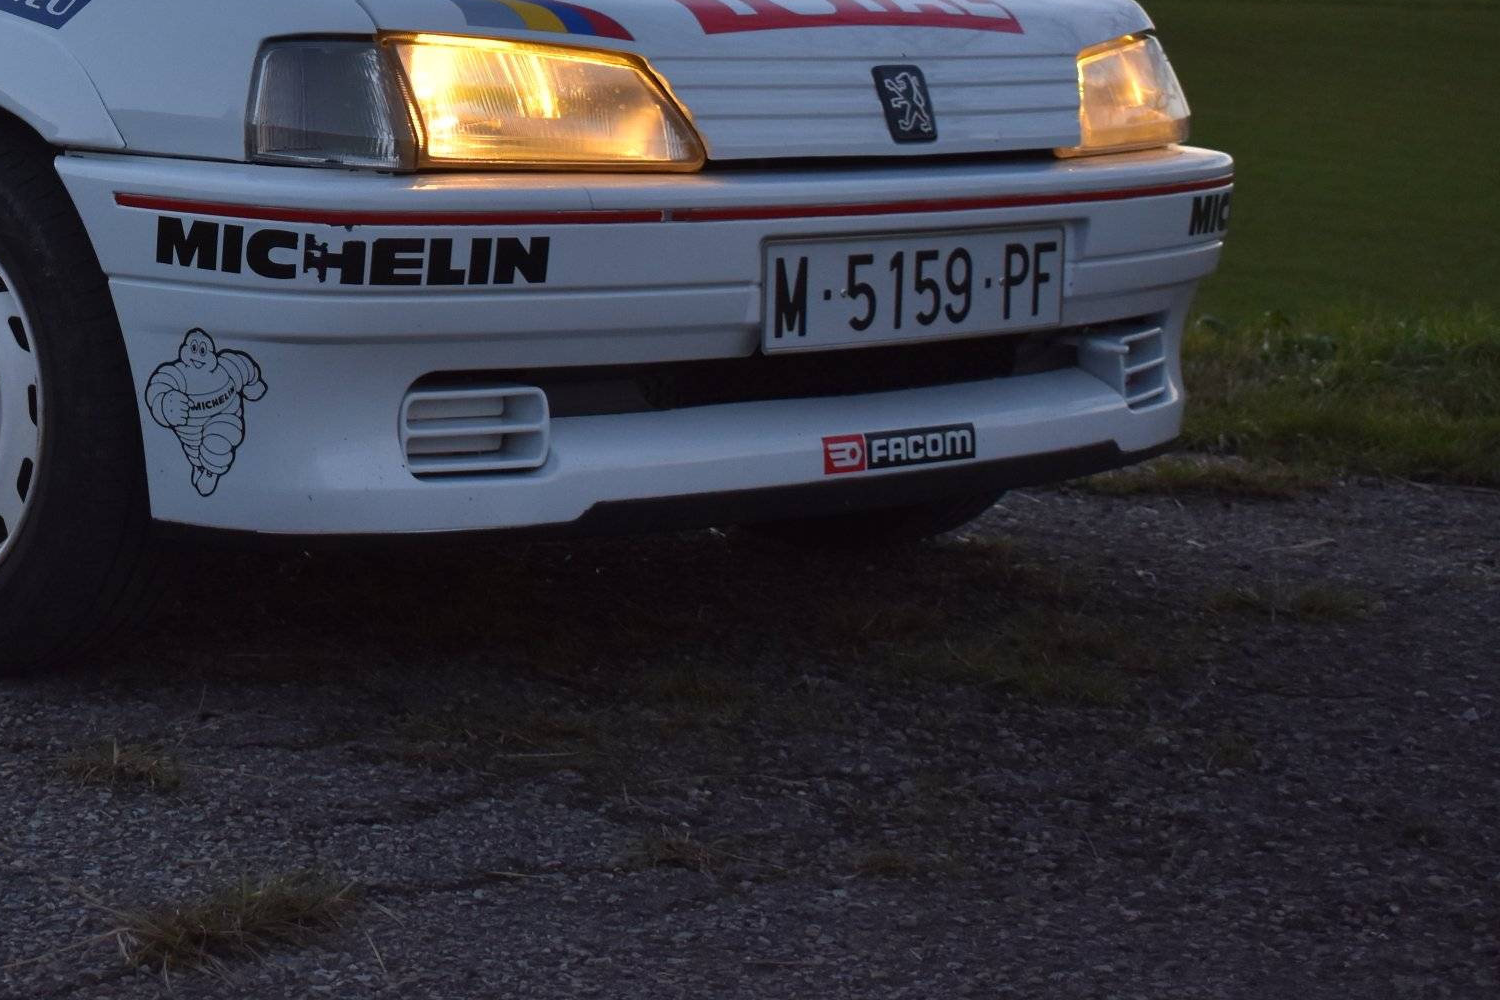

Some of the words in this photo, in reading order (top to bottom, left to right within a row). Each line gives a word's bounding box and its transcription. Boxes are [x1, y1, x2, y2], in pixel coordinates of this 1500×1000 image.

[155, 215, 551, 286] MICHELIN
[189, 385, 235, 412] MICHELIN
[870, 428, 973, 464] FACOM
